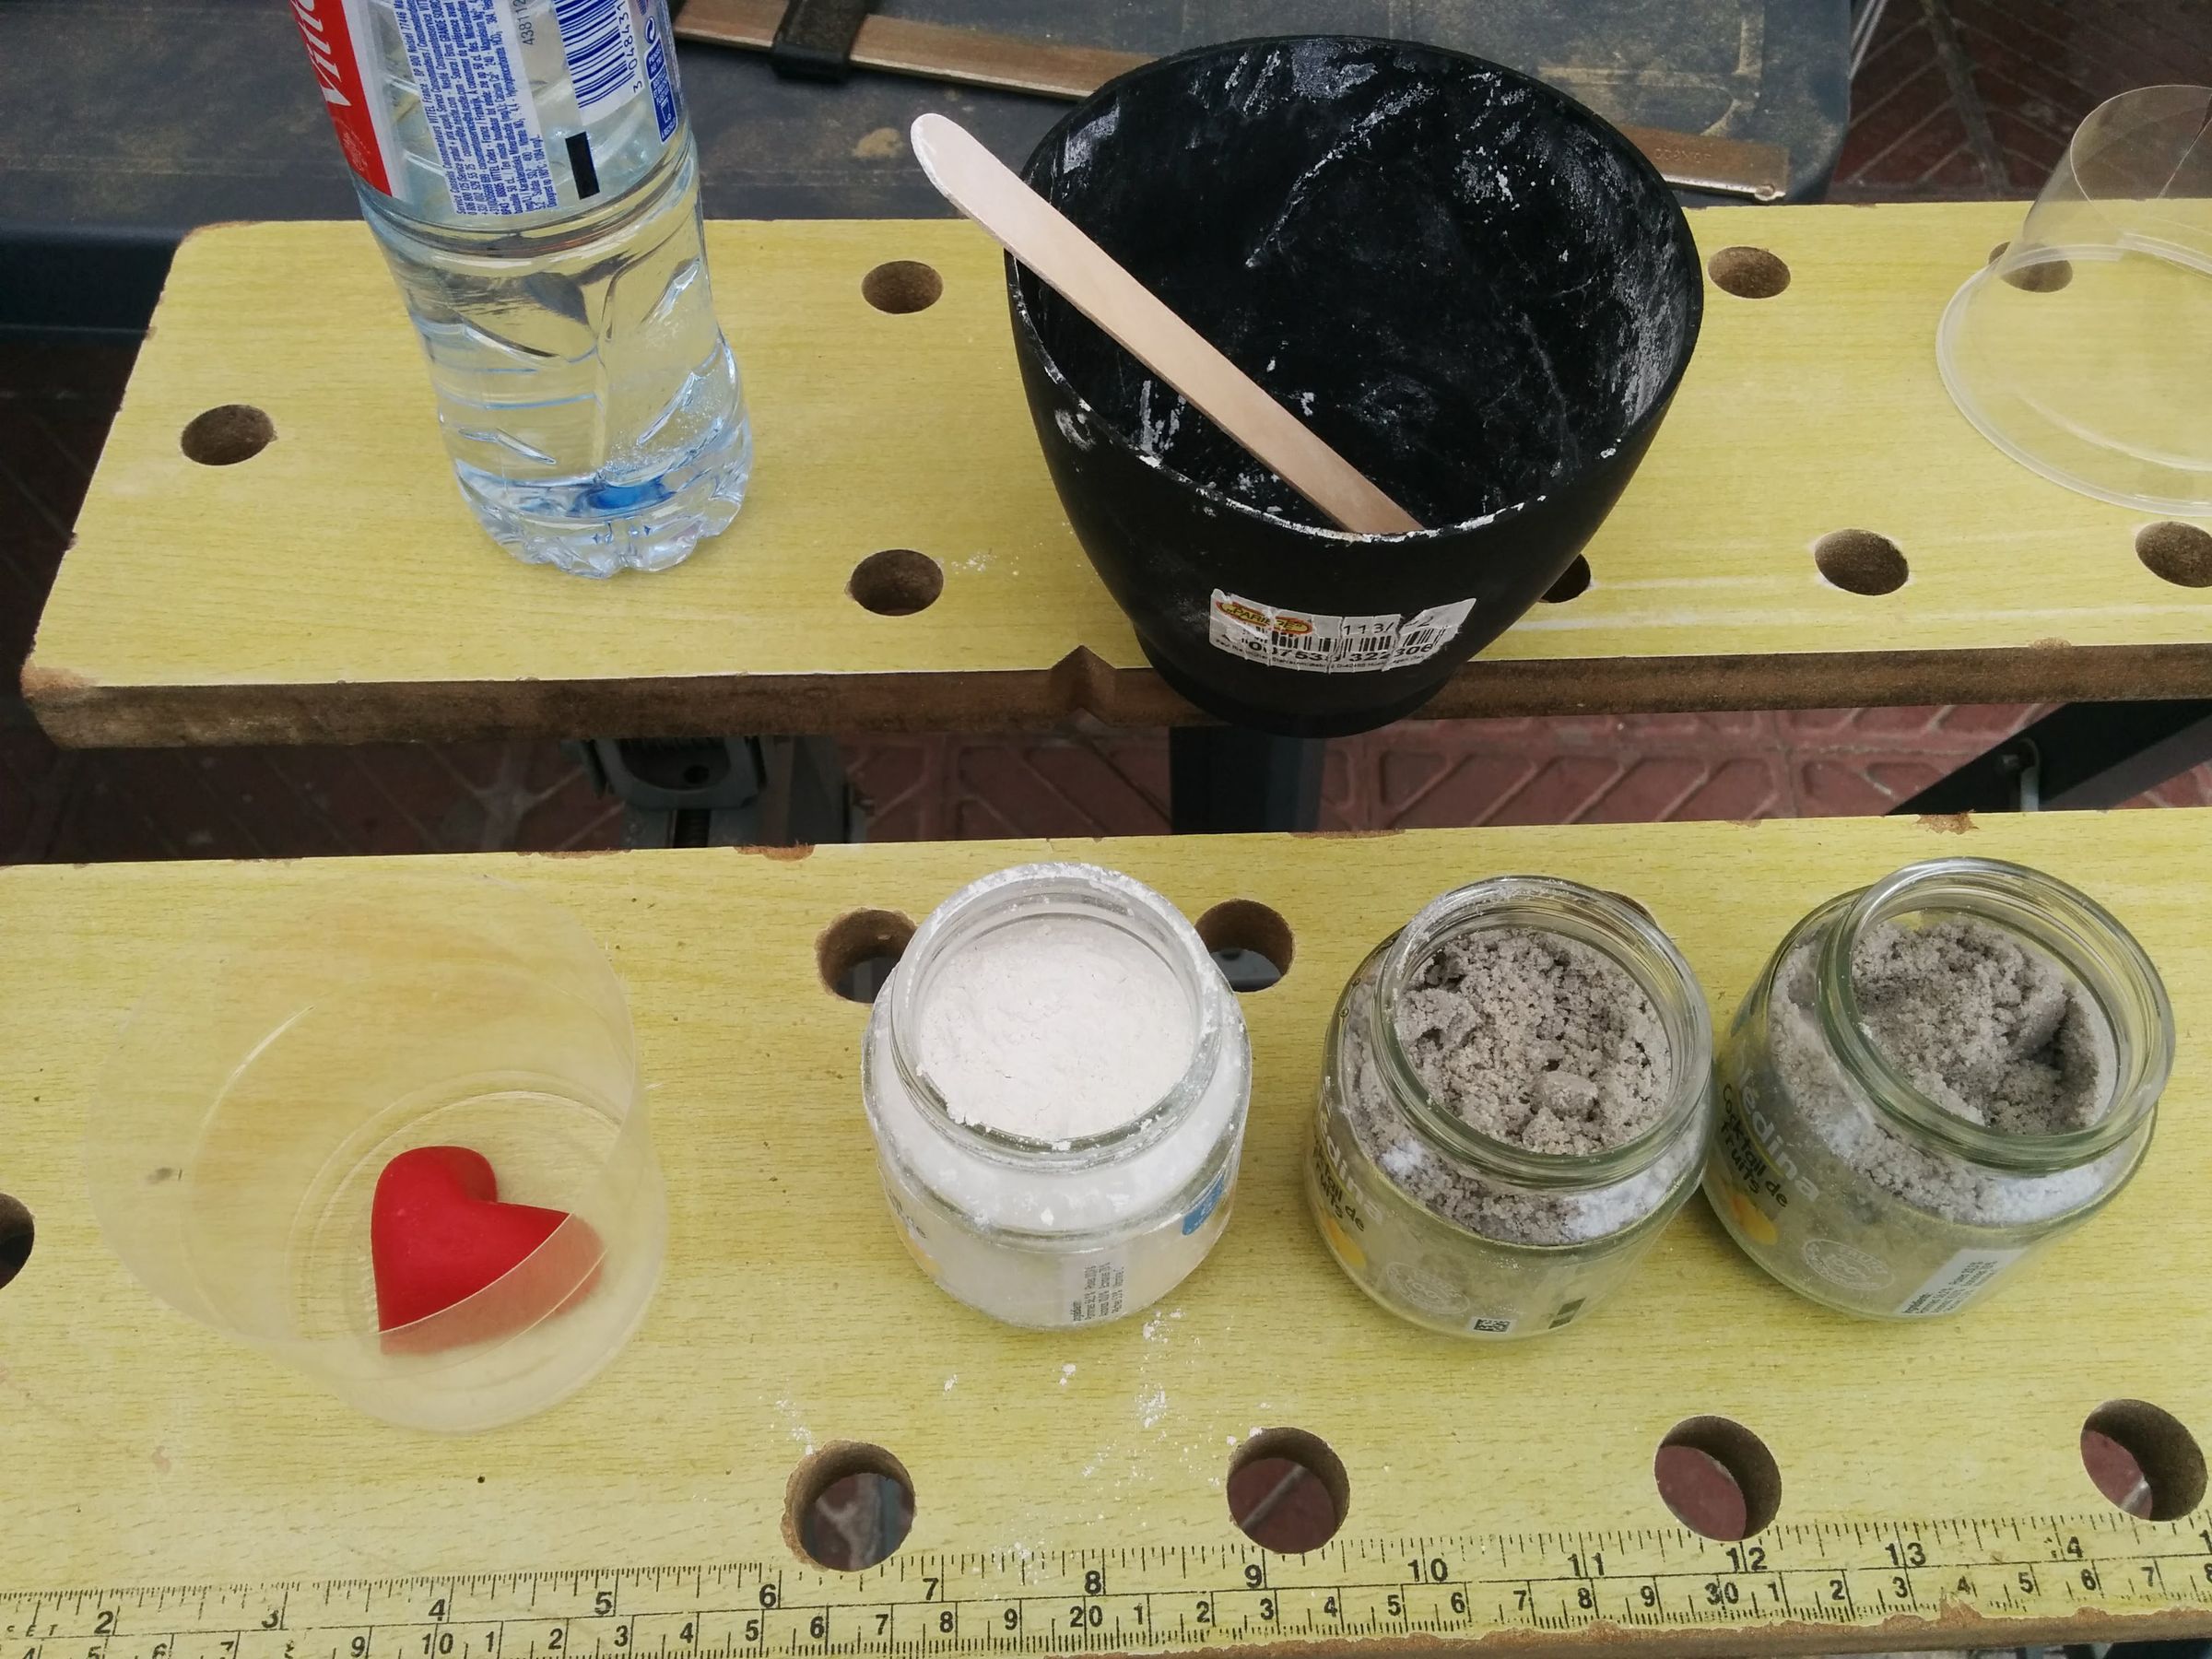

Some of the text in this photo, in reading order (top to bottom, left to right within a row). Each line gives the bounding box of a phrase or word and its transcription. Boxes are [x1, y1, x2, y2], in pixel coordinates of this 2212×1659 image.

[1765, 1180, 1789, 1208] de
[94, 1610, 114, 1635] 2
[261, 1608, 279, 1630] 3
[428, 1598, 446, 1622] 4
[594, 1591, 613, 1617] 5
[759, 1583, 777, 1608] 6
[922, 1577, 939, 1601] 7
[1084, 1571, 1102, 1595] 8
[1244, 1564, 1263, 1589] 9
[350, 1635, 366, 1659] 9
[485, 1630, 495, 1653] 1
[547, 1628, 563, 1651] 2
[614, 1624, 629, 1648] 3
[679, 1622, 694, 1644] 4
[745, 1618, 759, 1642] 5
[809, 1615, 825, 1640] 6
[875, 1613, 889, 1636] 7
[939, 1610, 954, 1633] 8
[1004, 1607, 1018, 1630] 9
[1133, 1605, 1143, 1626] 1
[1195, 1600, 1211, 1623] 2
[1259, 1597, 1275, 1621] 3
[1324, 1595, 1338, 1618] 4
[1387, 1594, 1402, 1617] 5
[1450, 1591, 1466, 1614] 6
[1512, 1589, 1527, 1611] 7
[1577, 1587, 1594, 1609] 8
[1640, 1585, 1655, 1607] 9
[1767, 1581, 1780, 1602] 1
[1829, 1579, 1846, 1601] 2
[1892, 1576, 1909, 1599] 3
[1957, 1575, 1972, 1596] 4
[2018, 1571, 2034, 1594] 5
[2080, 1568, 2097, 1591] 6
[2141, 1566, 2155, 1587] 7
